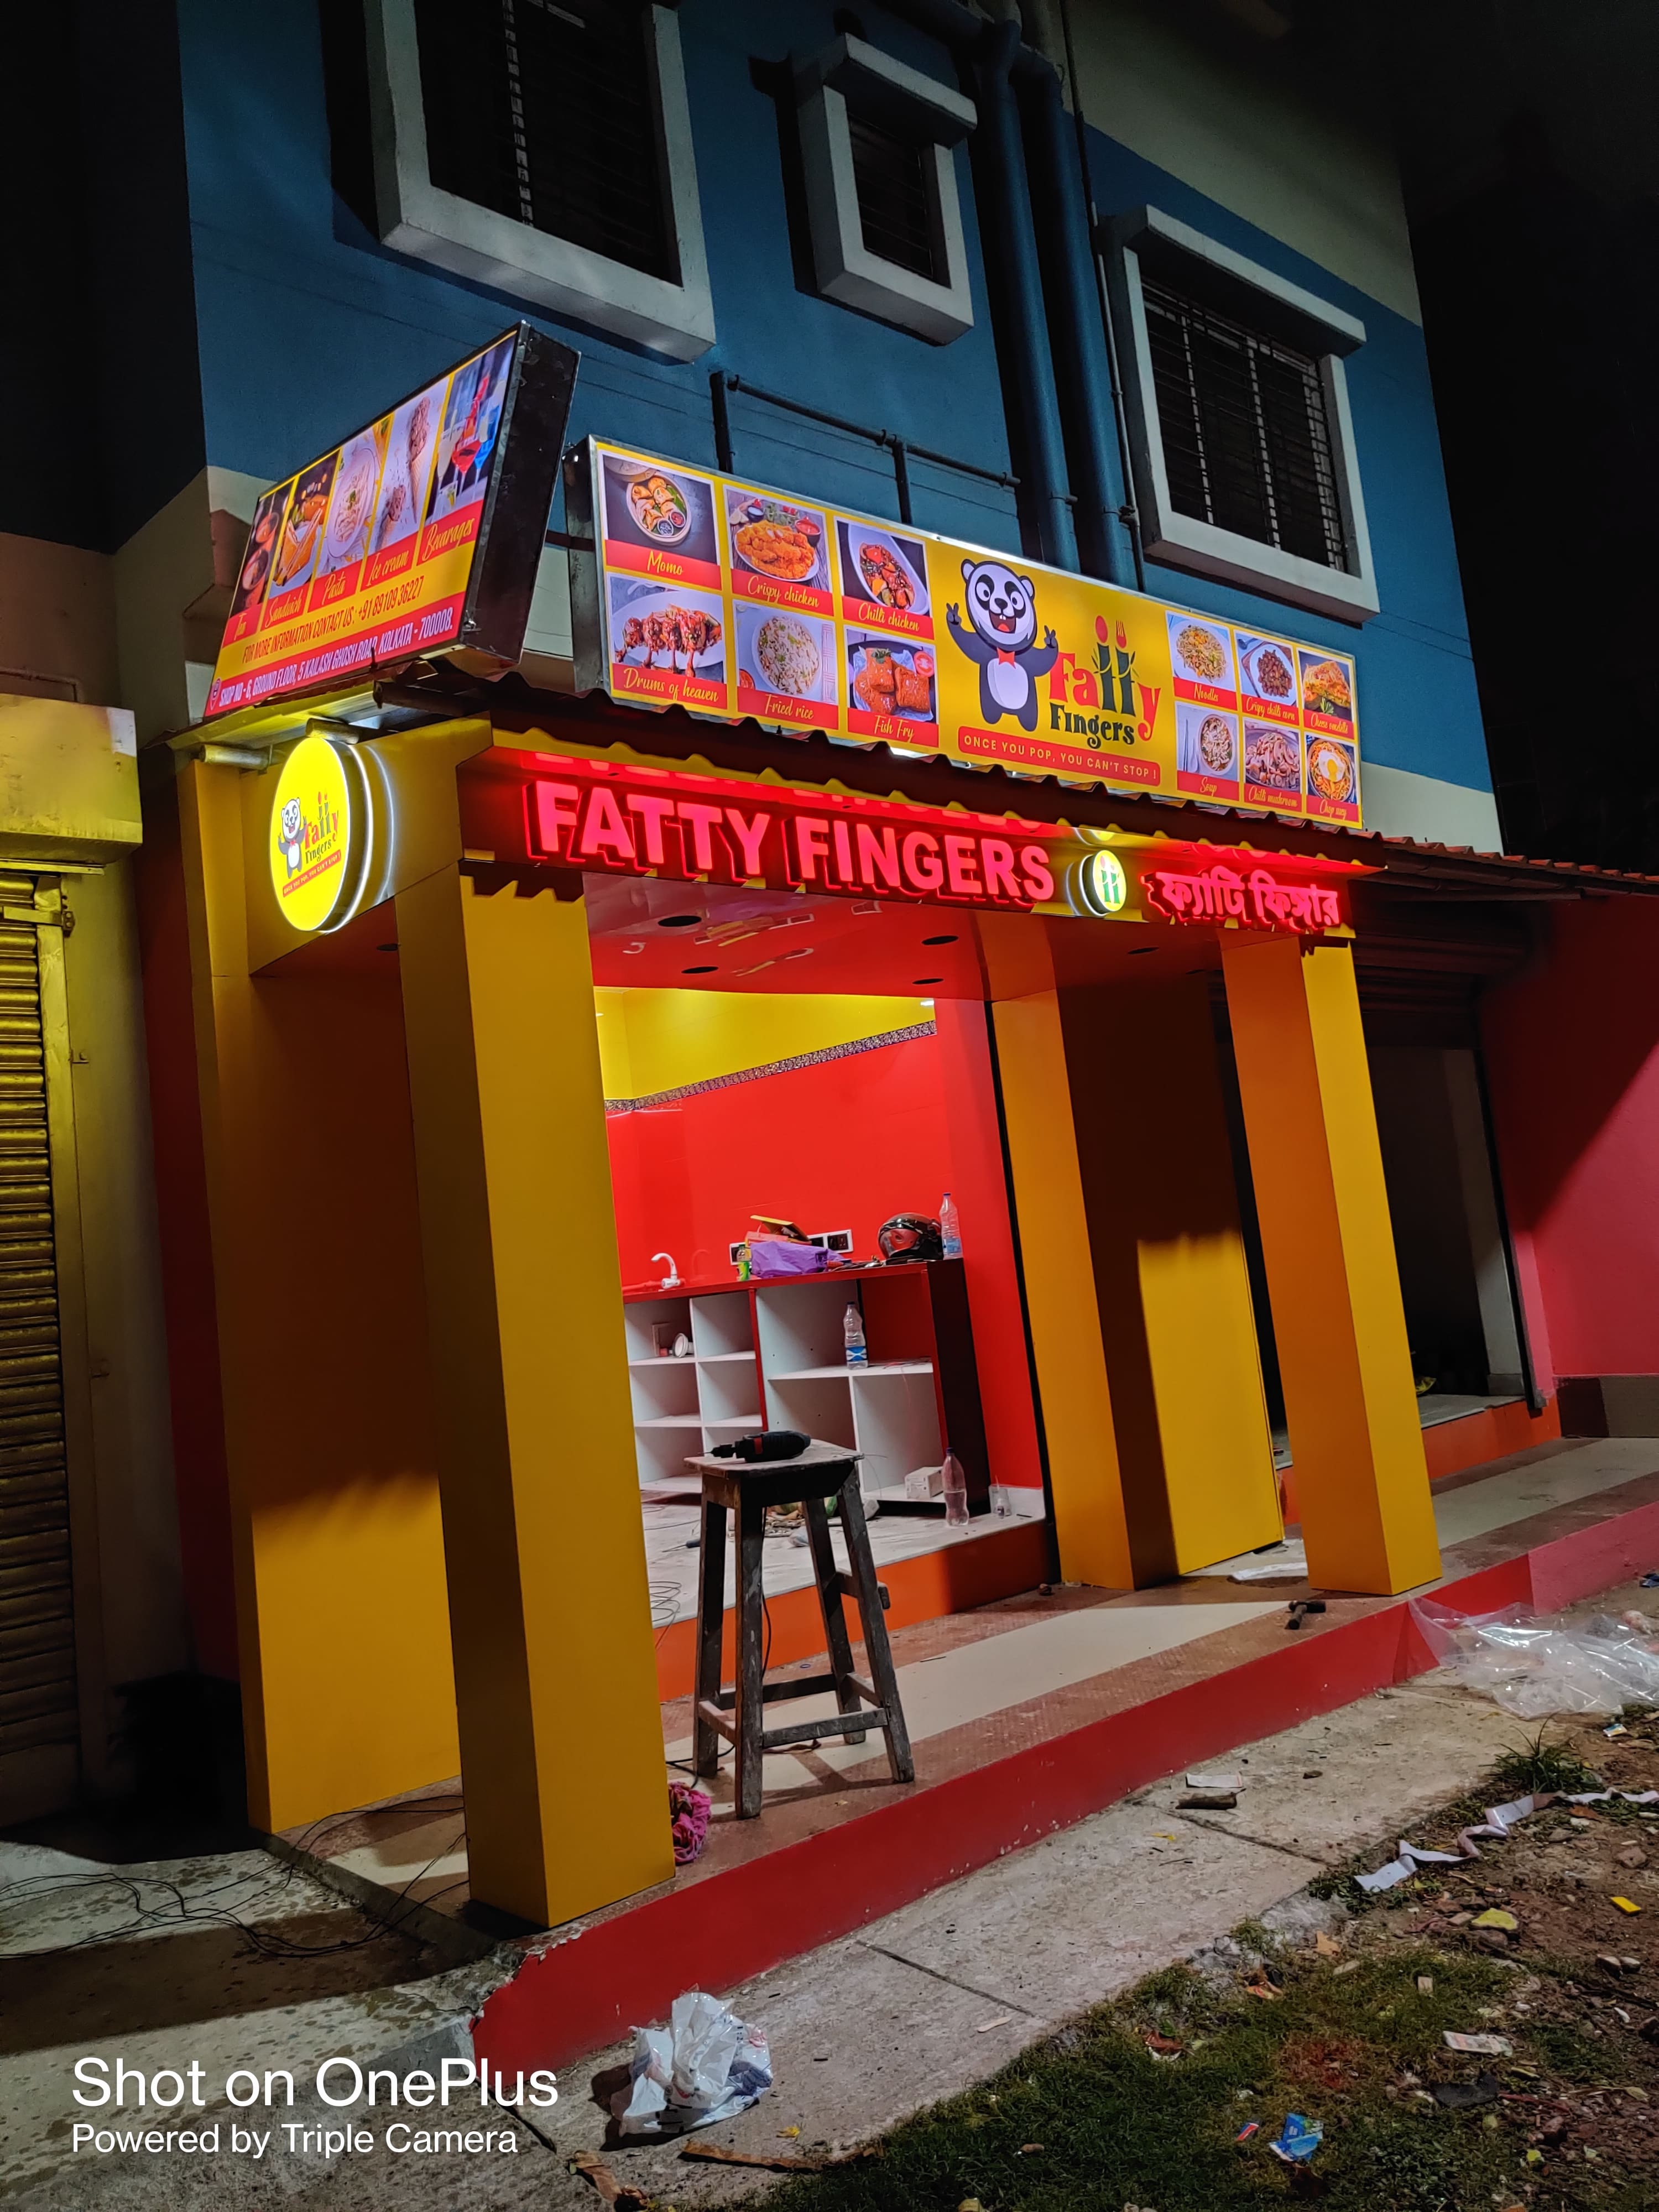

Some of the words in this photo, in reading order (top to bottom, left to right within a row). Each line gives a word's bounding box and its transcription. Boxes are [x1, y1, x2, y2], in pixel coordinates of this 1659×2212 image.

[366, 552, 382, 587] Ice
[382, 550, 409, 576] cream
[647, 552, 683, 576] Momo
[321, 571, 346, 605] Pasta
[747, 575, 781, 602] Crispy
[784, 587, 819, 608] chicken
[242, 645, 255, 664] FOR
[254, 637, 272, 660] MORE
[270, 621, 314, 654] INFORMATION
[312, 609, 345, 639] CONTACT
[358, 599, 373, 620] +91
[372, 587, 398, 616] 89109
[397, 575, 425, 606] 36227
[858, 602, 886, 624] Chilli
[887, 612, 920, 632] chicken
[218, 685, 236, 707] SHOP
[252, 671, 277, 696] GROUND
[298, 661, 305, 680] 5
[303, 650, 335, 679] KAILASH
[331, 642, 357, 670] GHOSH
[378, 622, 414, 655] KOLKATA
[623, 667, 666, 692] Drums
[669, 682, 680, 701] of
[682, 684, 719, 702] heaven
[1194, 684, 1219, 702] Noodles
[765, 693, 794, 715] Fried
[795, 704, 814, 721] rice
[1267, 703, 1281, 717] chilli
[1282, 711, 1295, 721] corn
[1311, 713, 1328, 729] Cheese
[873, 714, 894, 736] Fish
[895, 719, 915, 742] Fry
[1049, 702, 1135, 749] Fingers
[964, 734, 997, 751] ONCE
[1001, 740, 1025, 756] YOU
[1027, 745, 1057, 761] POP,
[1060, 752, 1083, 766] YOU
[1087, 757, 1120, 774] CAN'T
[1123, 763, 1151, 779] STOP
[1200, 776, 1217, 797] Soup
[1249, 785, 1266, 802] Chilli
[535, 780, 771, 875] FATTY
[795, 816, 1055, 901] FINGERS
[1155, 865, 1245, 916] ফ্যাটি
